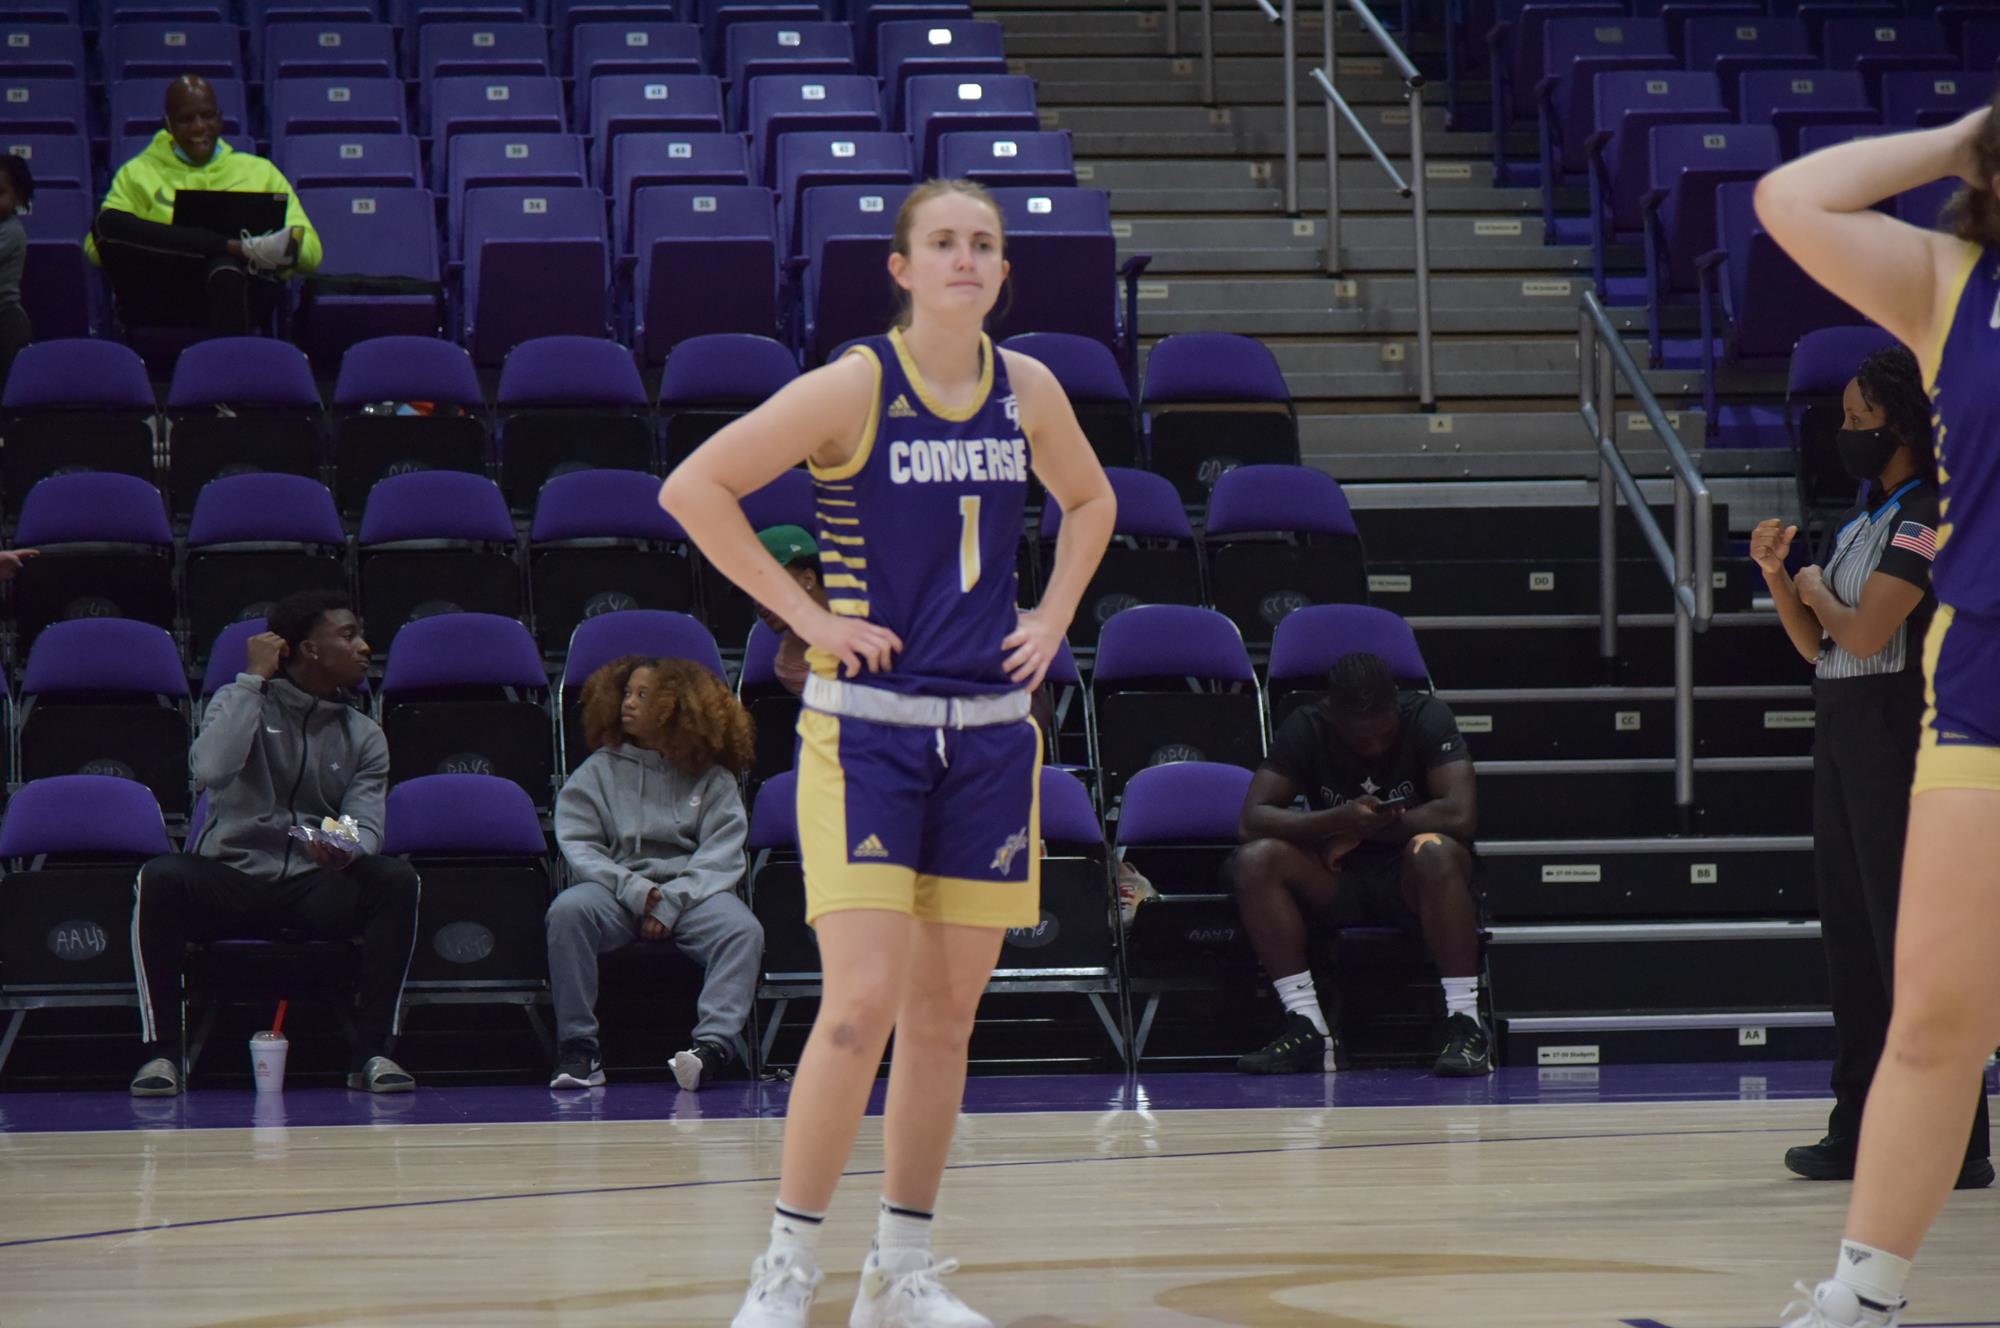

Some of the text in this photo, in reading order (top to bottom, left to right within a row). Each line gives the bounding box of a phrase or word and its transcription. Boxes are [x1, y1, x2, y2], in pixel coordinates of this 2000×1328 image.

[889, 438, 1027, 484] CONVERSE
[958, 495, 982, 593] 1
[1535, 576, 1550, 586] DD
[1621, 716, 1635, 726] CC
[1696, 868, 1712, 879] BB
[56, 926, 108, 953] AA43
[1744, 1030, 1760, 1041] AA
[1570, 1050, 1596, 1060] Students
